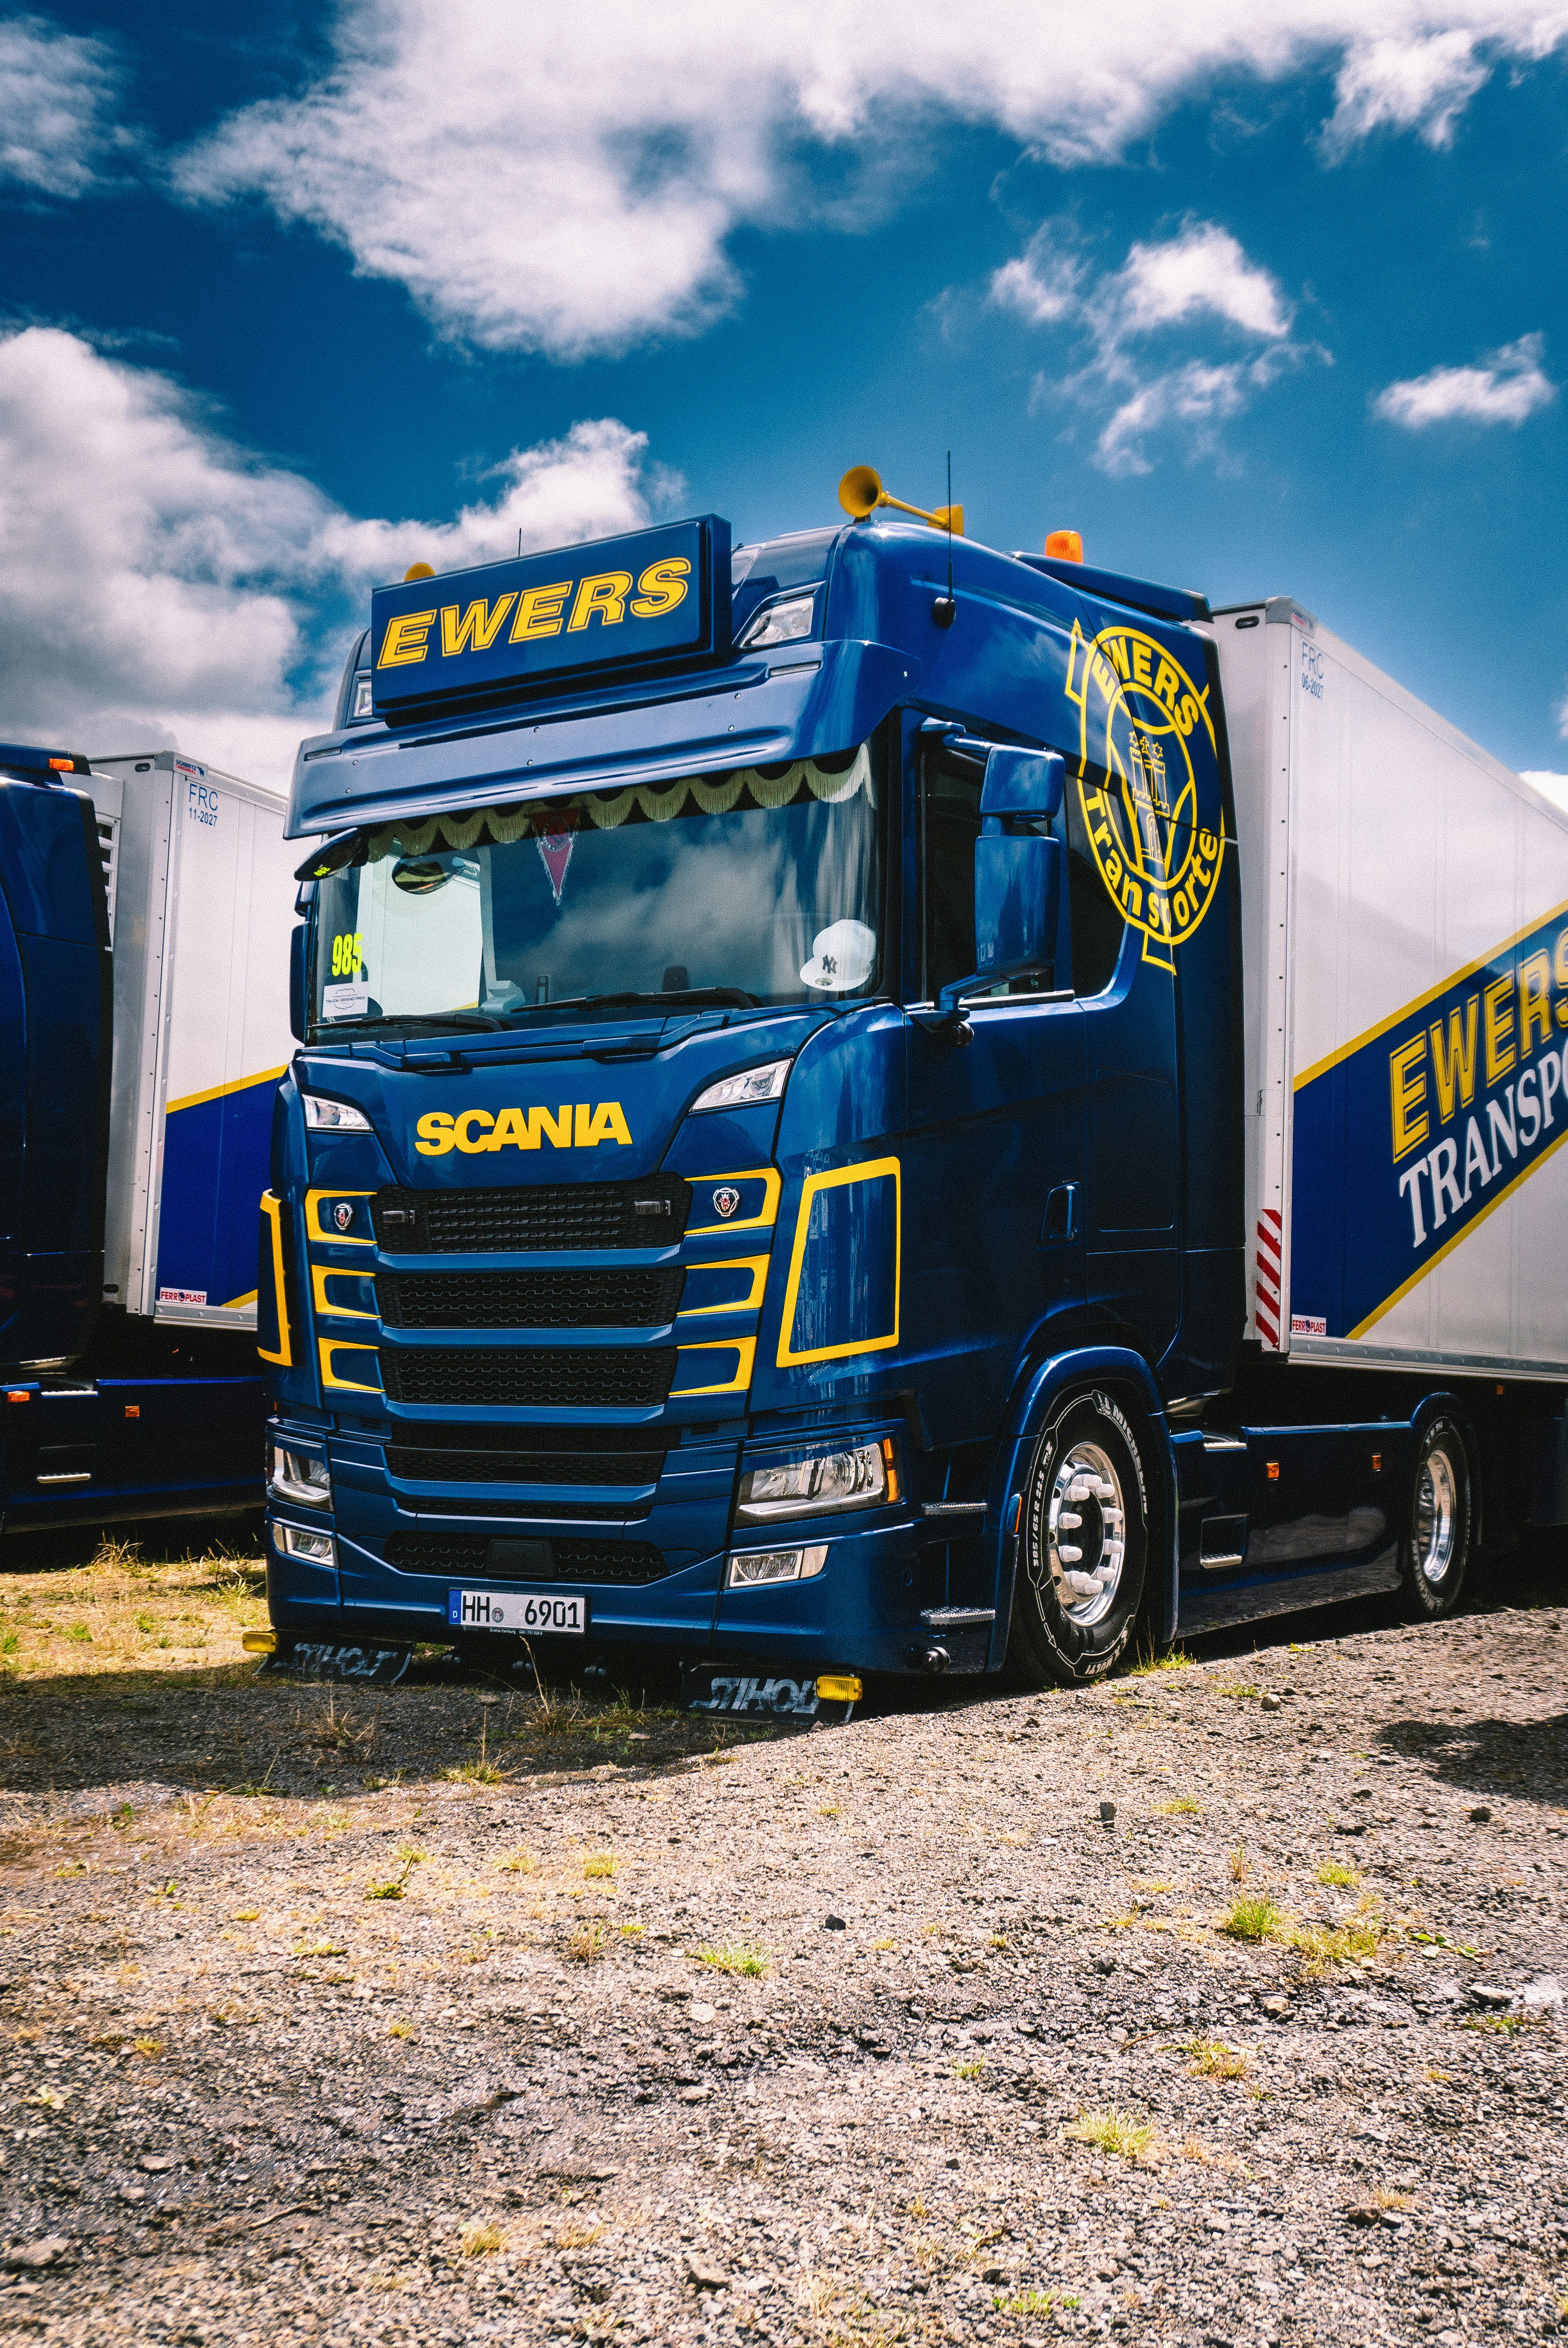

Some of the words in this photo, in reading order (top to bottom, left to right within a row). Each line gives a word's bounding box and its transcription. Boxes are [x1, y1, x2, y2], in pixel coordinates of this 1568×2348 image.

[376, 557, 692, 670] EWERS
[1302, 641, 1324, 679] FRC
[1092, 637, 1199, 736] EWERS
[1302, 672, 1324, 699] 06-2027
[175, 759, 196, 770] SCHMITZ
[189, 783, 218, 811] FRC
[189, 807, 218, 827] 11-2027
[1085, 787, 1218, 930] Transporte
[332, 933, 363, 976] 985
[415, 1102, 633, 1156] SCANIA
[1399, 1031, 1568, 1249] TRANSP
[160, 1291, 206, 1303] FERROPLAST
[1292, 1319, 1326, 1333] FERROPLAST
[1113, 1405, 1147, 1514] MICHELIN
[1036, 1470, 1045, 1499] 22.5
[452, 1610, 458, 1618] D
[462, 1595, 490, 1622] HH
[525, 1599, 580, 1628] 6901
[1085, 1656, 1113, 1674] MULTI
